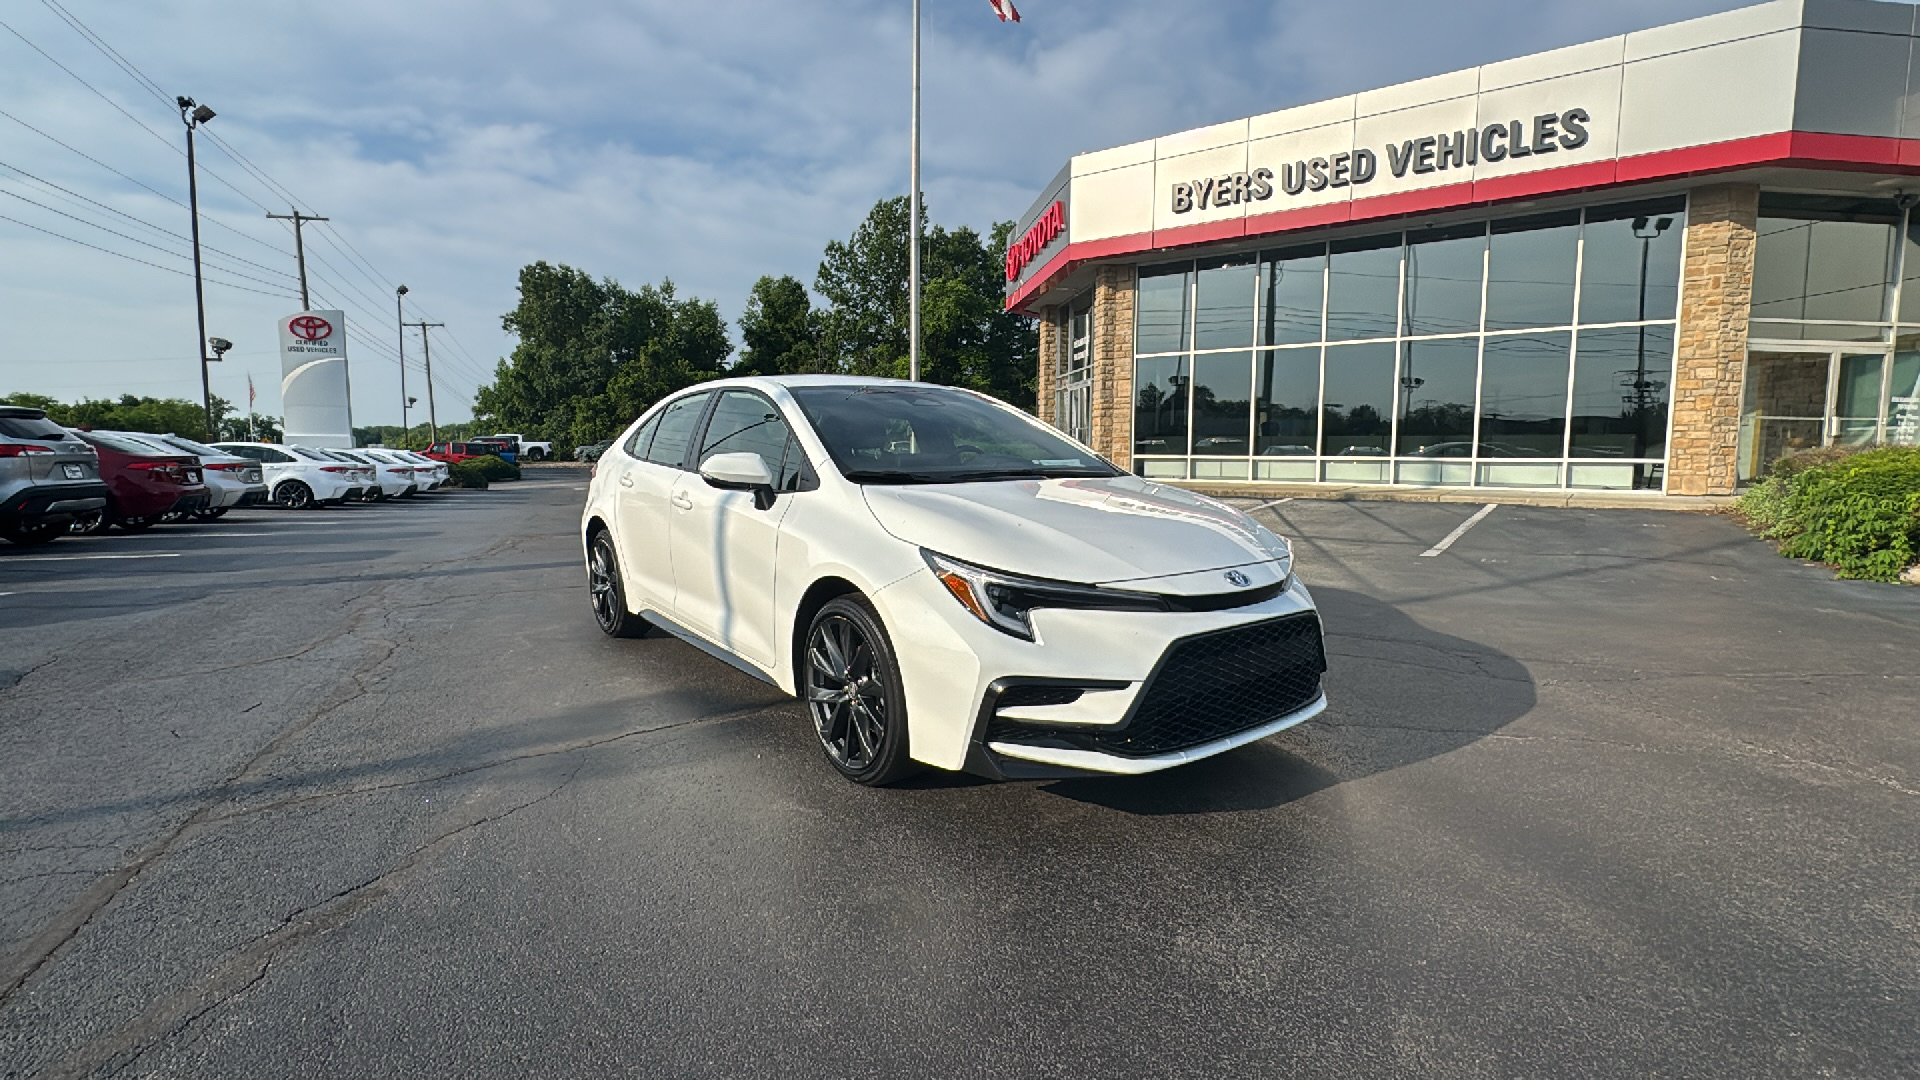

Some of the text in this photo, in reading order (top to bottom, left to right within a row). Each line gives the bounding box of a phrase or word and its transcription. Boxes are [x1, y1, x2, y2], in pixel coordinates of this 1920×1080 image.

[1172, 107, 1590, 214] BYERS USED VEHICLES
[1019, 201, 1065, 268] TOYOTA
[306, 346, 337, 354] VEHICLES
